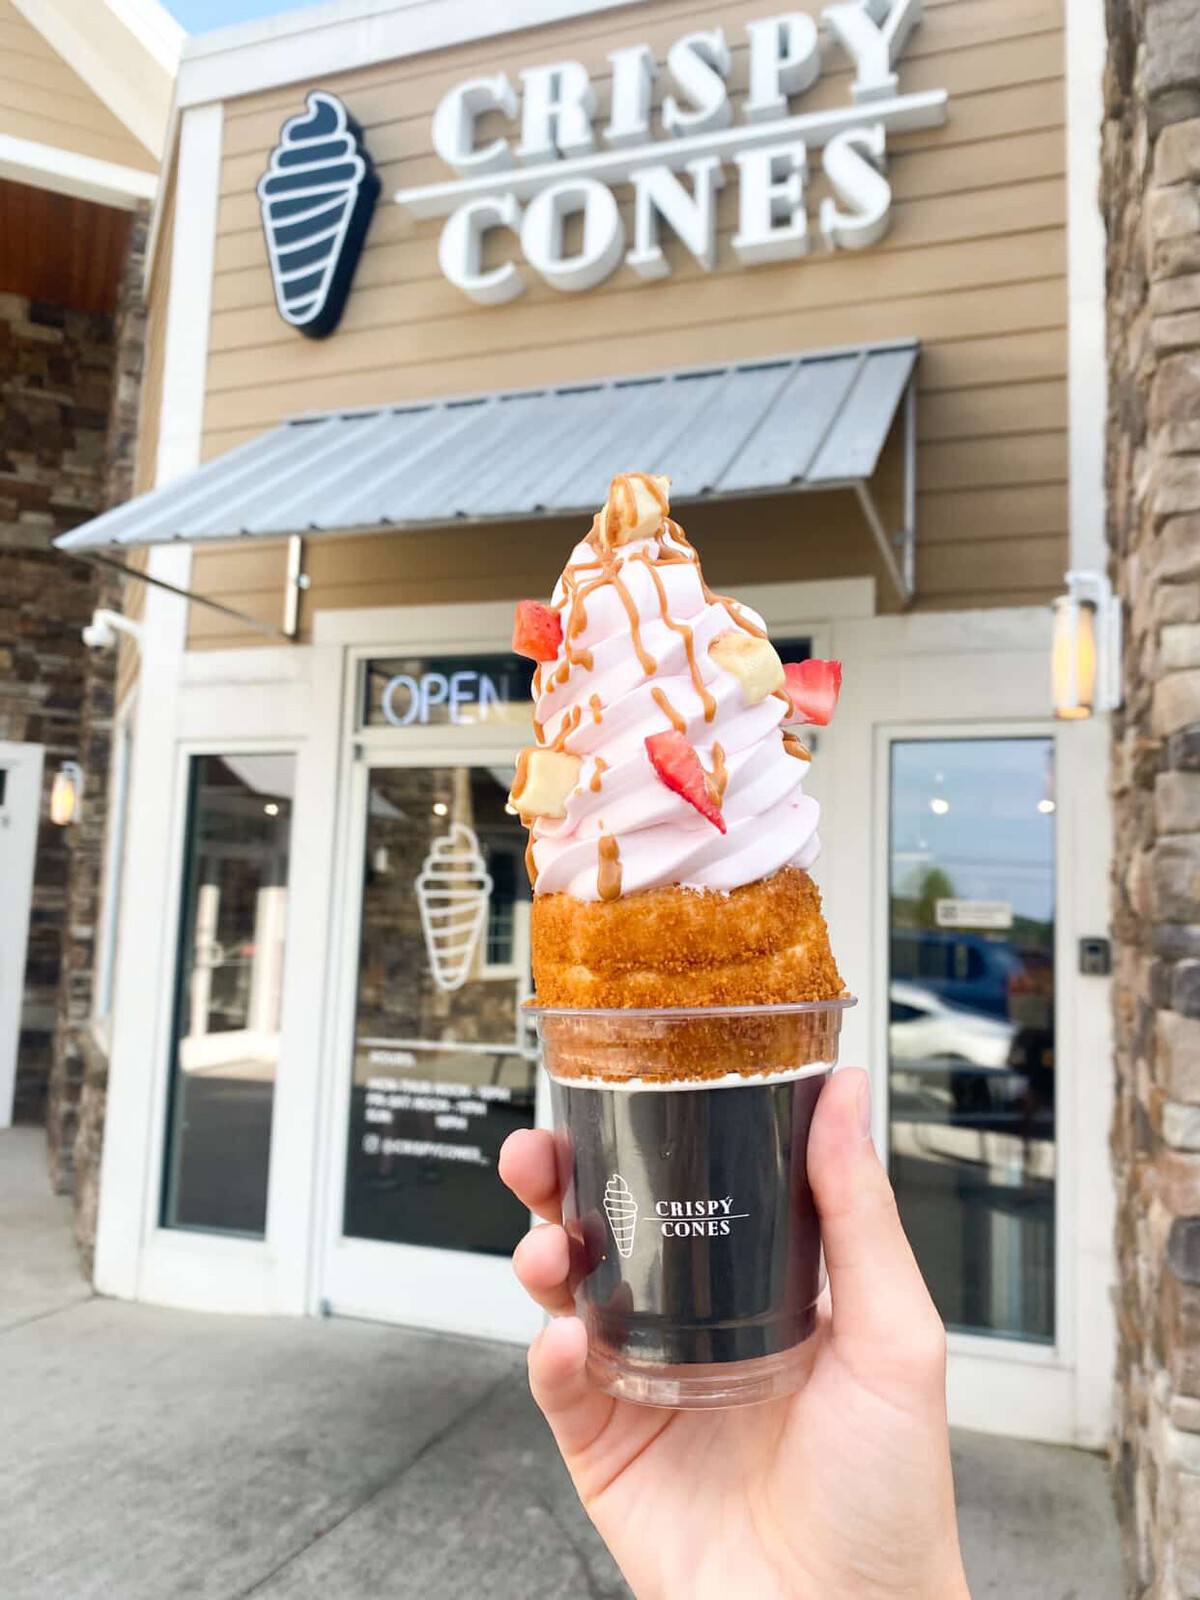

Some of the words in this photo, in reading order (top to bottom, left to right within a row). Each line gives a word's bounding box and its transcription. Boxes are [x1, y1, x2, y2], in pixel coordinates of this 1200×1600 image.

[432, 0, 922, 178] CRISPY
[438, 124, 896, 306] CONES
[382, 670, 511, 727] OPEN
[661, 1220, 731, 1238] CONES
